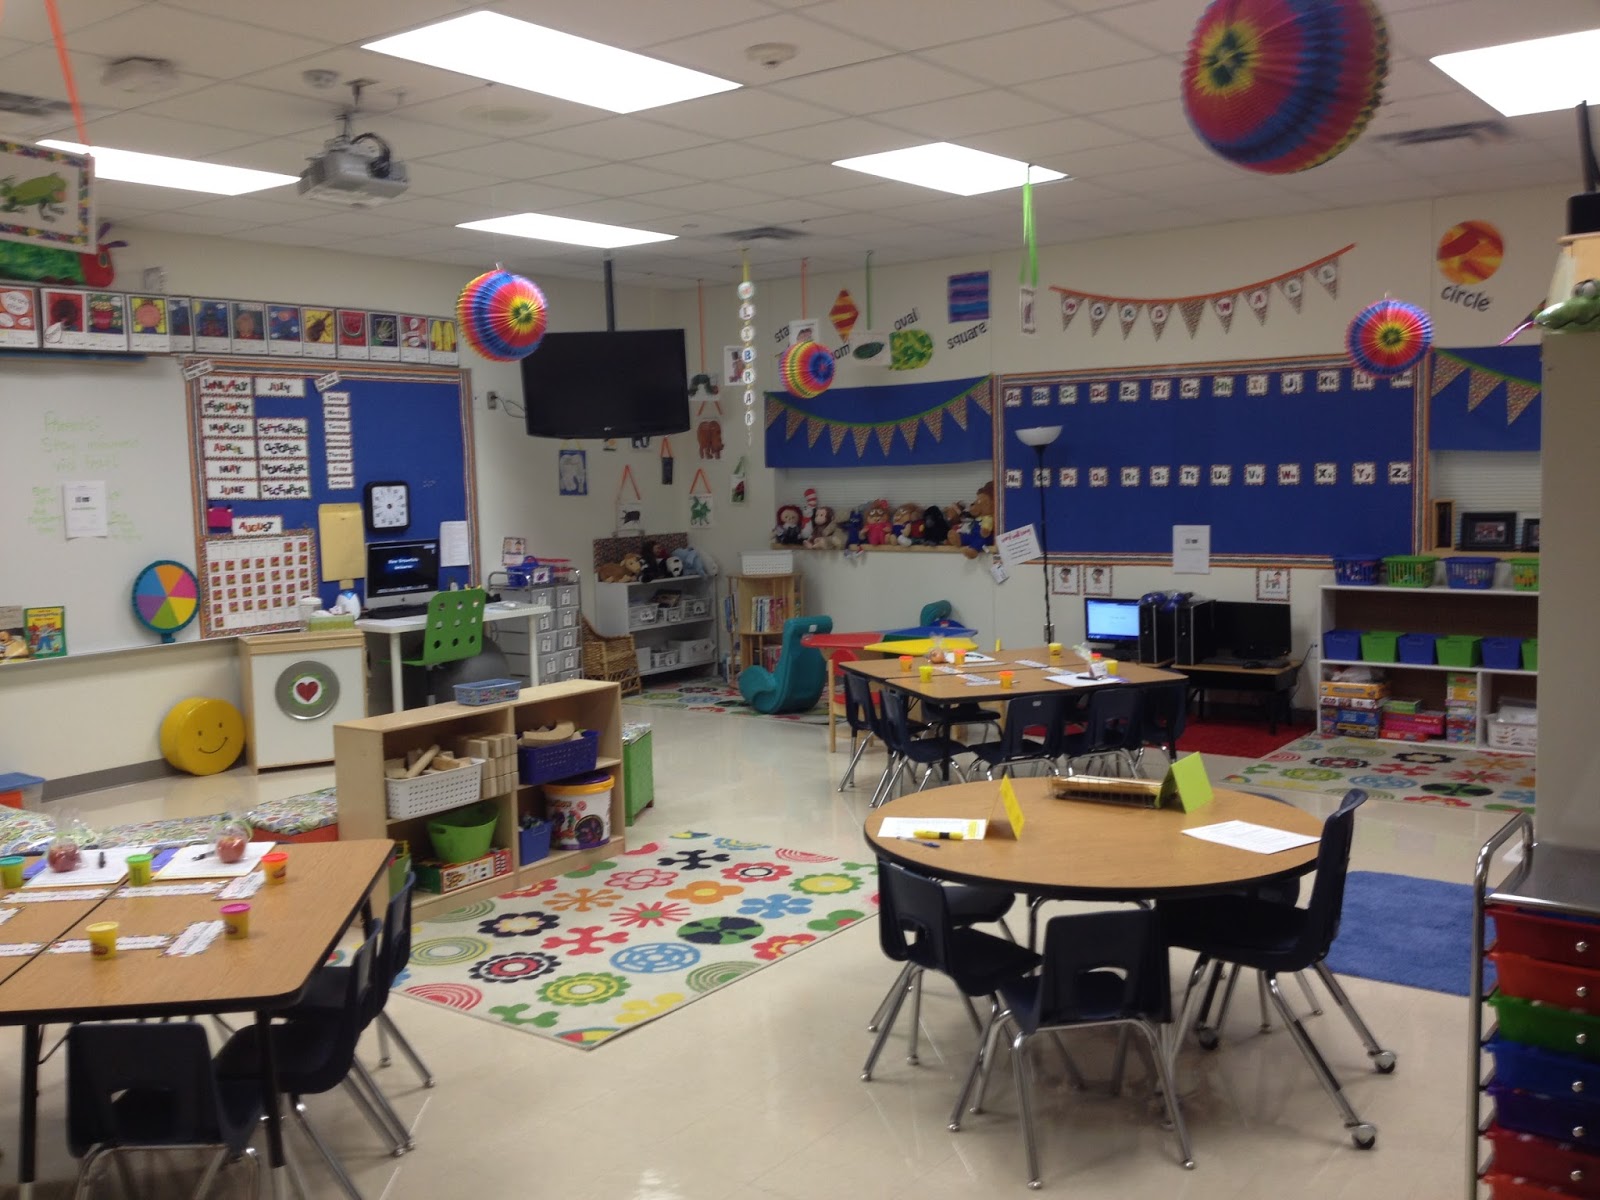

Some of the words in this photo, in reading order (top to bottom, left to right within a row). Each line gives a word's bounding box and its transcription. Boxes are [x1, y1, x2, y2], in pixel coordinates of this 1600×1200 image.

[1065, 301, 1165, 320] WORD
[1219, 269, 1333, 312] WALL
[1441, 284, 1490, 312] circle
[894, 307, 919, 331] oval
[774, 325, 790, 344] sta
[946, 321, 988, 351] square
[203, 378, 248, 392] JANUARY
[268, 382, 291, 393] JULY
[1122, 387, 1135, 396] Ee
[1154, 384, 1167, 394] Ff
[1182, 382, 1198, 395] Gg
[1215, 381, 1230, 391] Hh
[1251, 380, 1264, 390] Ii
[1286, 377, 1298, 391] Jj
[1320, 375, 1336, 386] Kk
[204, 400, 249, 413] FEBRUARY
[209, 423, 245, 434] MARCH
[259, 423, 307, 435] SEPTEMBER
[214, 443, 244, 455] APRIL
[263, 443, 301, 455] OCTOBER
[219, 464, 242, 474] MAY
[261, 463, 306, 475] NOVEMBER
[1063, 473, 1074, 483] Pp
[1124, 472, 1136, 481] Rr
[1184, 470, 1196, 480] Tt
[1249, 469, 1261, 479] Vv
[1318, 468, 1332, 479] Xx
[1356, 468, 1371, 481] Yy
[1391, 467, 1408, 479] Zz
[219, 485, 245, 495] JUNE
[262, 484, 307, 496] DECEMBER
[239, 521, 274, 533] AUGUST
